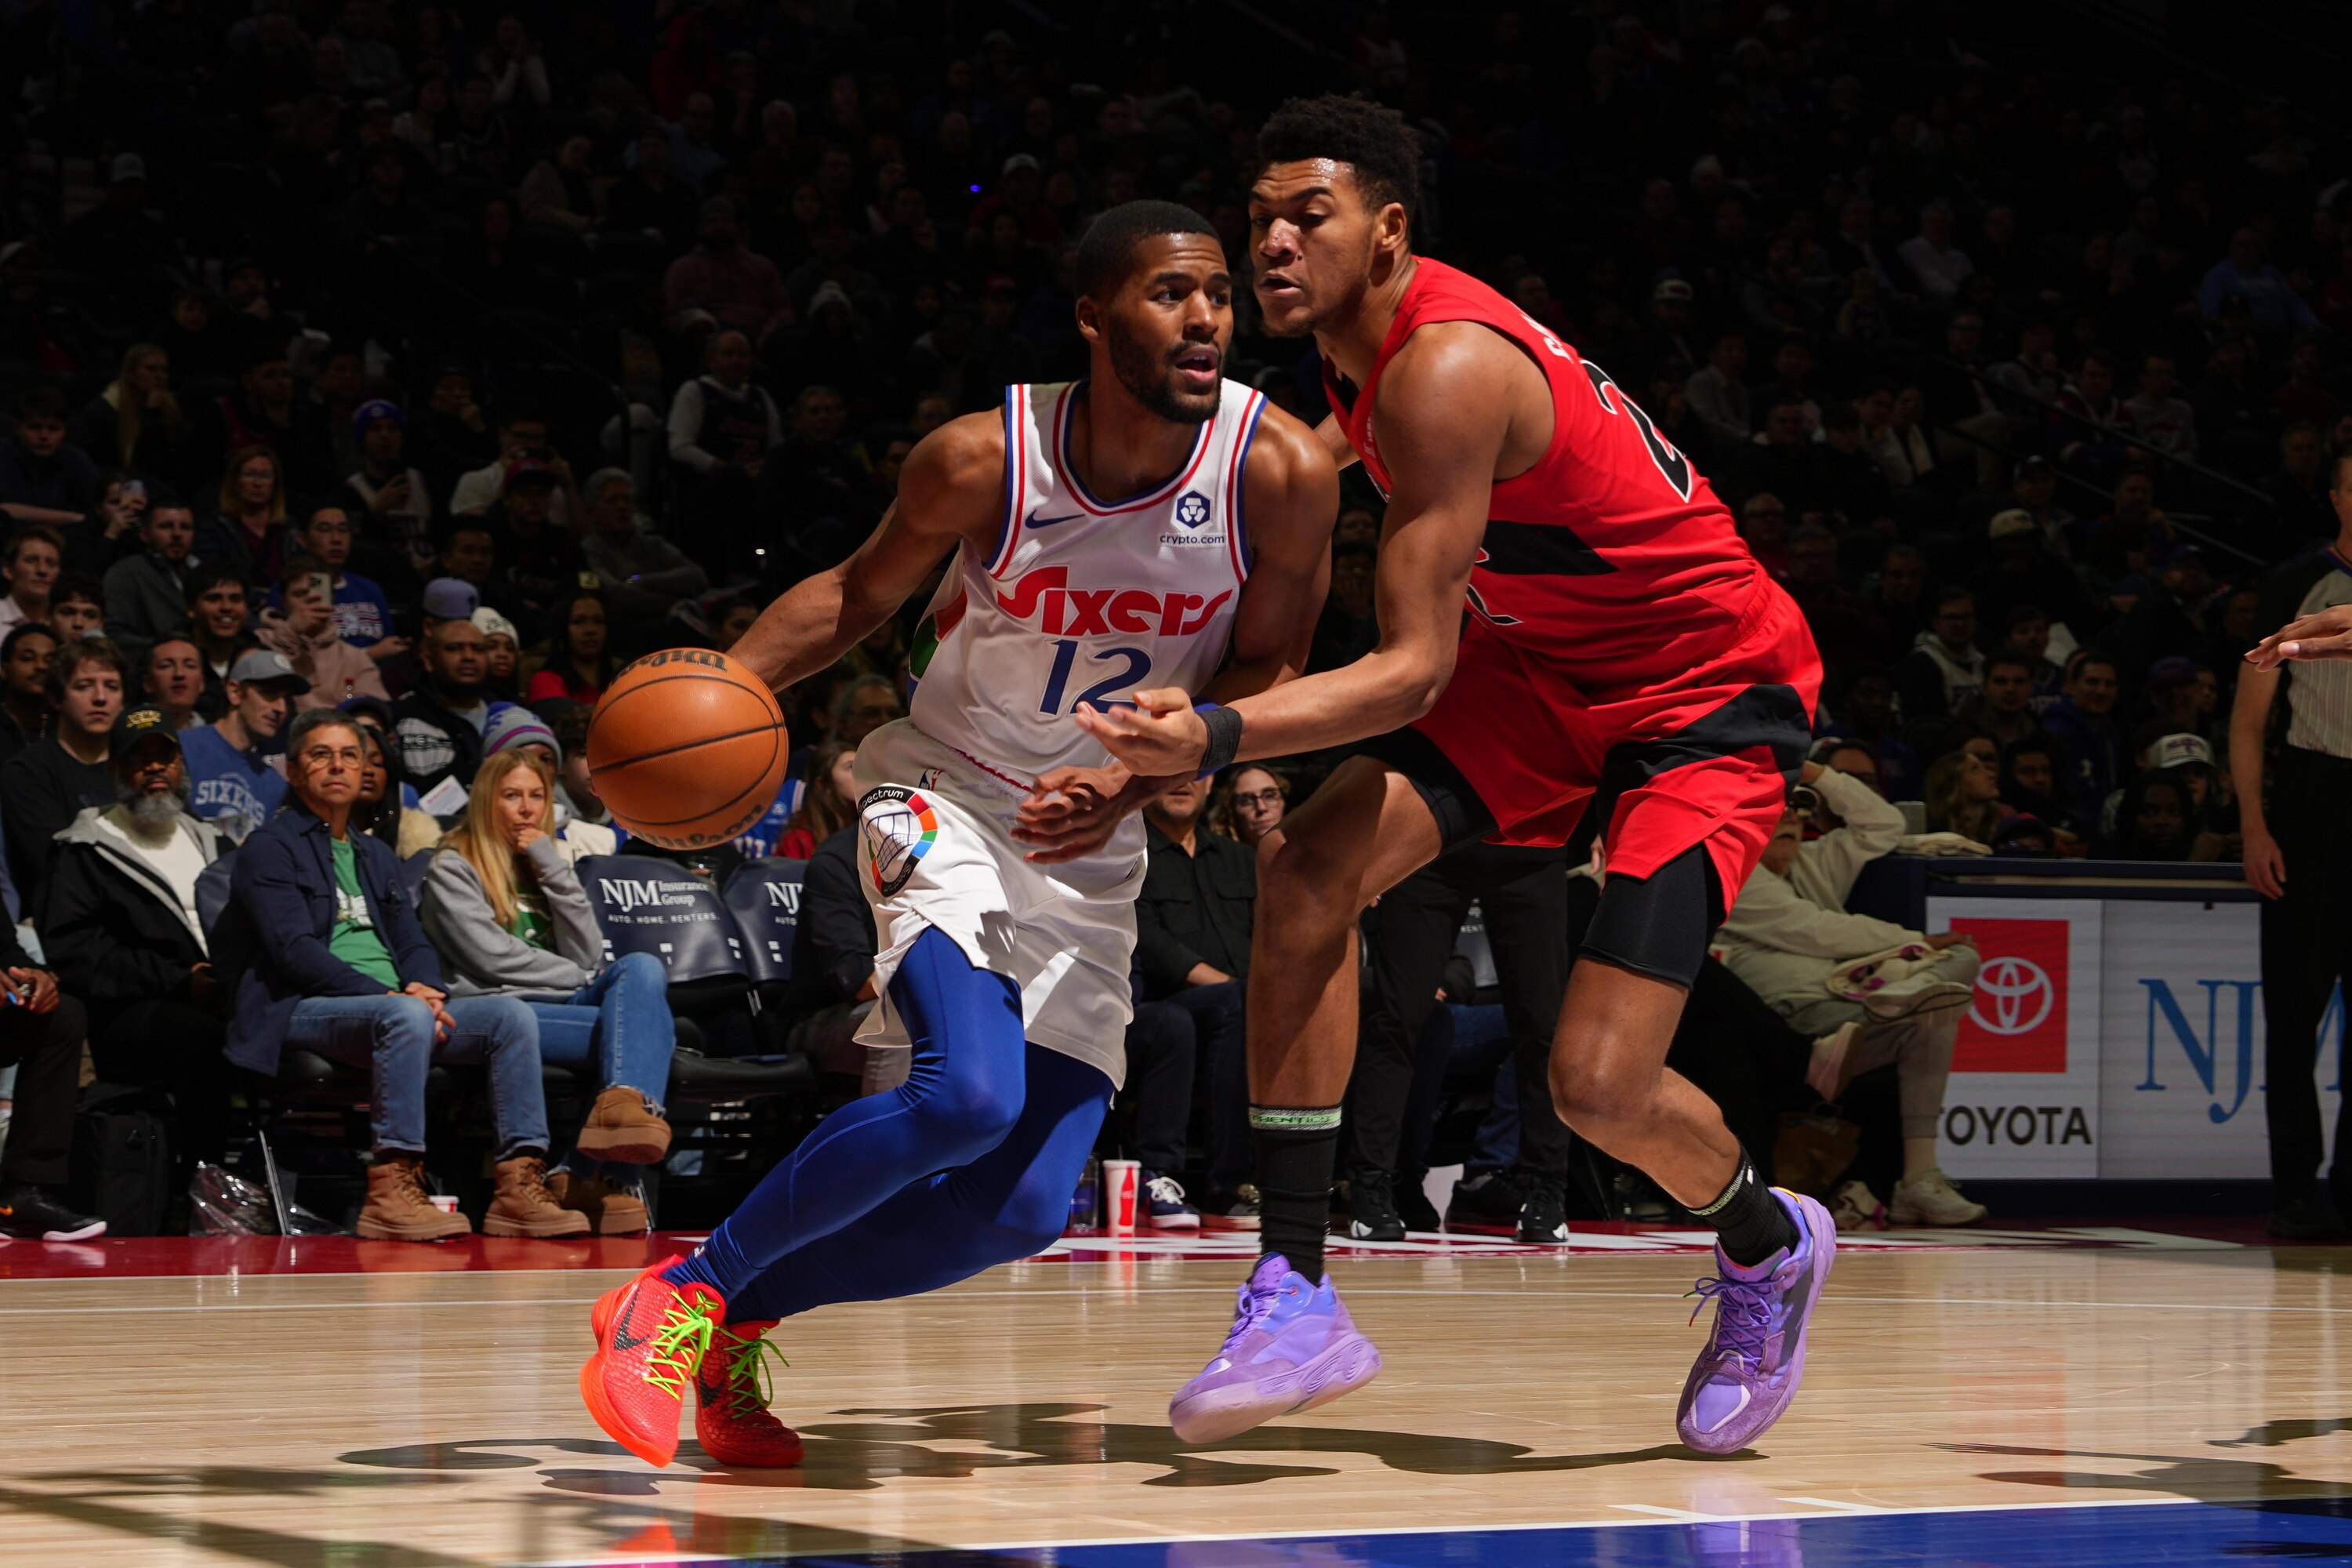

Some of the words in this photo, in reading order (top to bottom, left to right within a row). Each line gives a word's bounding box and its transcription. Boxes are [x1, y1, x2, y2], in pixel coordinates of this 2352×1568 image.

[1160, 534, 1225, 545] crypto.com
[996, 565, 1234, 637] Sixers
[1038, 639, 1153, 717] 12
[597, 878, 662, 913] NJM
[661, 893, 696, 907] Group
[763, 881, 804, 915] NJ
[1940, 1105, 2093, 1145] OYOTA
